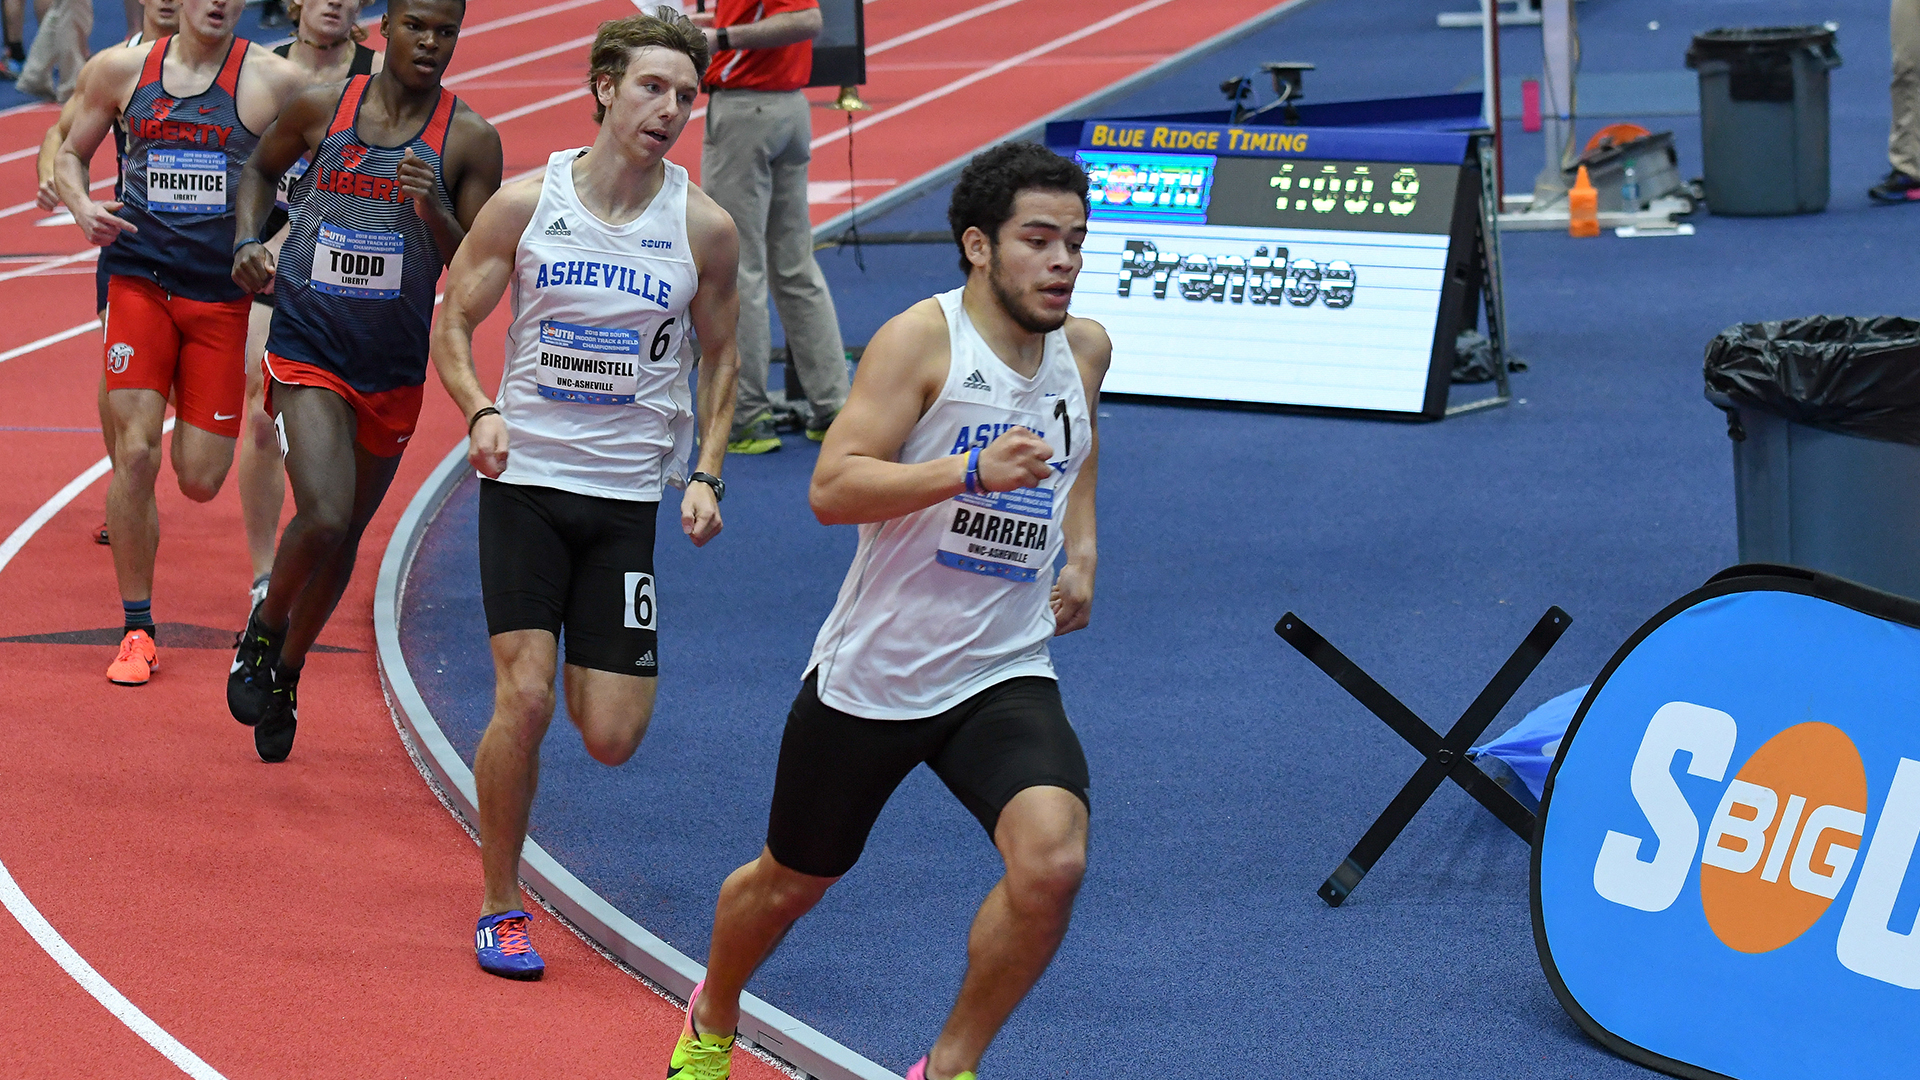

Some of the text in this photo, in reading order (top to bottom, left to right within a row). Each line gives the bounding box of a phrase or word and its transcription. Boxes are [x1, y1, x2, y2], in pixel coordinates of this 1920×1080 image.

[129, 117, 233, 146] LIBERTY
[1091, 125, 1309, 153] BLUE RIDGE TIMING
[150, 172, 223, 192] PRENTICE
[316, 167, 405, 204] LIBERT
[173, 193, 197, 201] LIBERTY
[641, 239, 672, 249] SOUTH
[330, 250, 385, 277] TODD
[341, 276, 369, 286] LIBERTY
[535, 261, 672, 309] ASHEVILLE
[597, 337, 617, 345] TRACK
[649, 317, 676, 362] 6
[540, 352, 634, 377] BIRDWHISTELL
[557, 377, 614, 391] UNC-ASHEVILLE
[963, 381, 992, 392] adidas
[1053, 399, 1071, 457] 1
[950, 508, 1048, 551] BARRERA
[968, 543, 1028, 564] UNC-ASHEVILLE
[634, 577, 652, 626] 6
[1702, 779, 1867, 900] BIG
